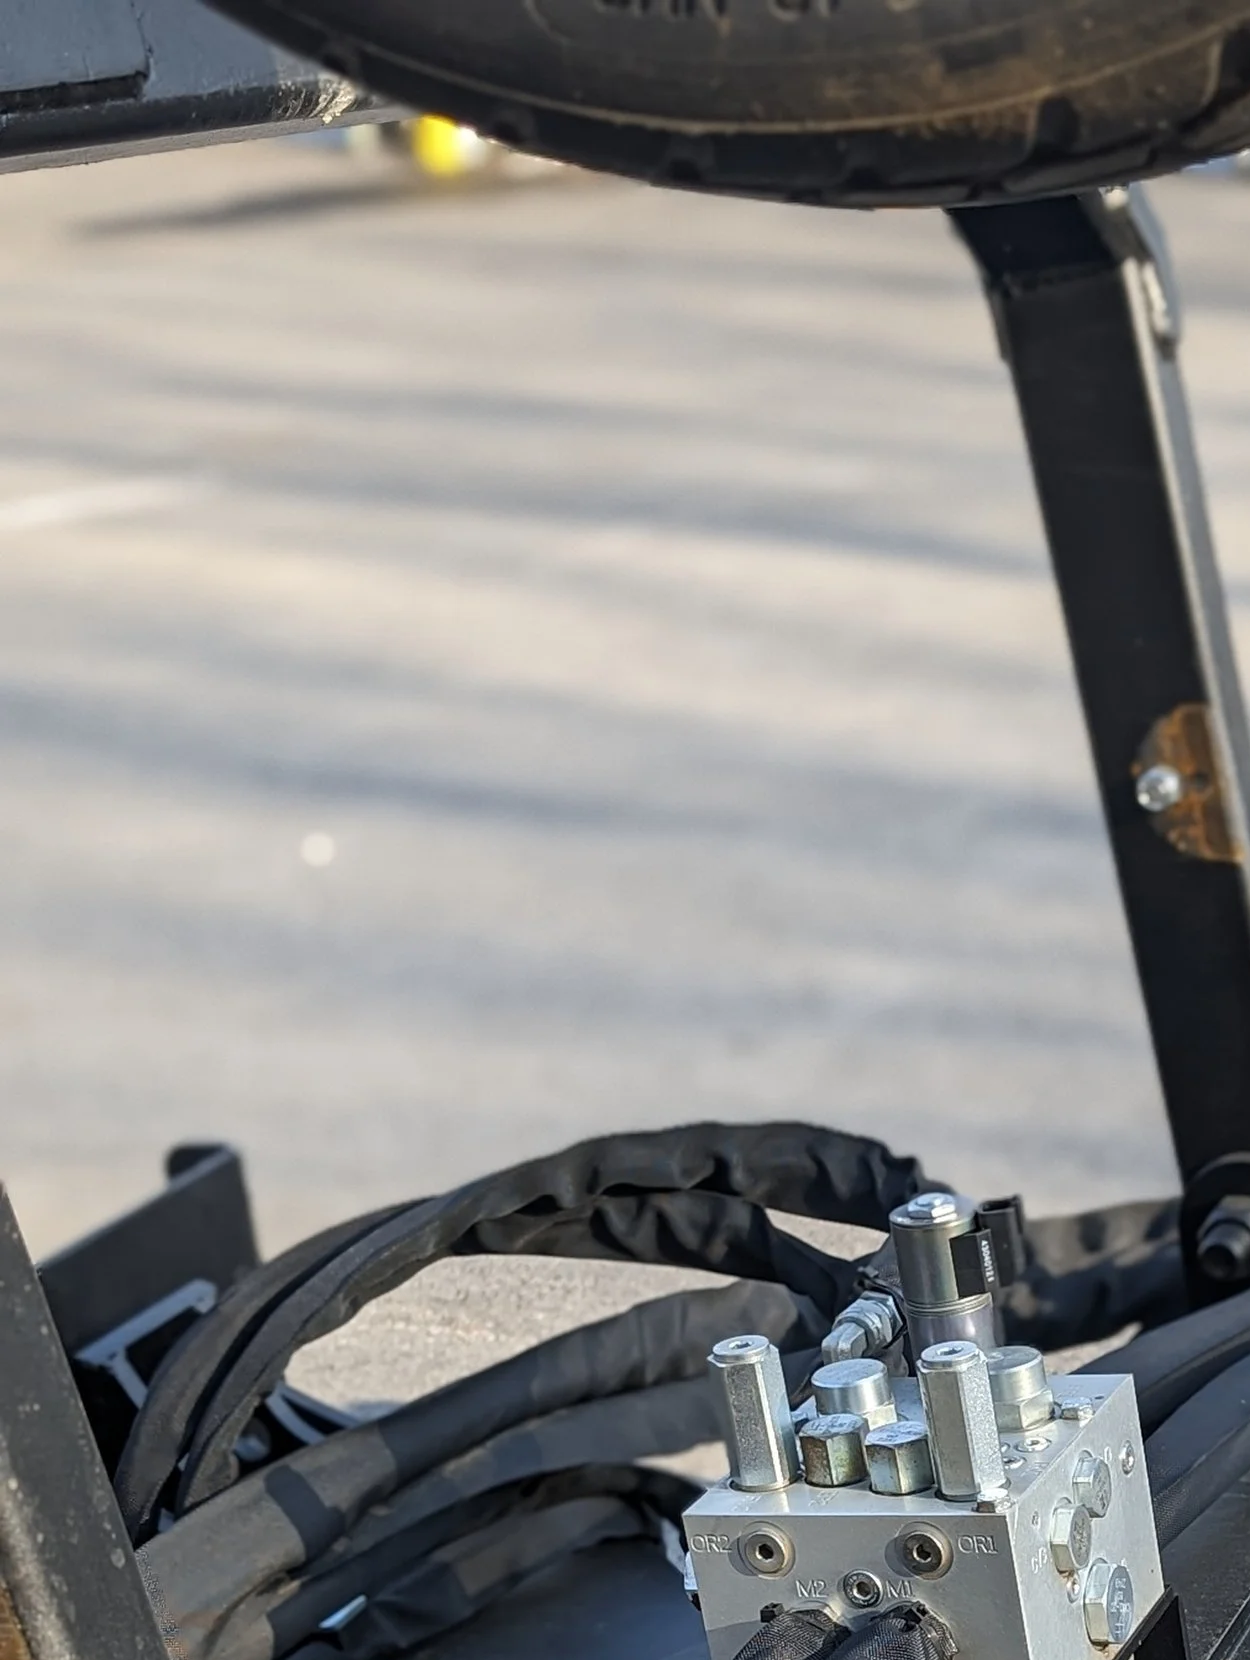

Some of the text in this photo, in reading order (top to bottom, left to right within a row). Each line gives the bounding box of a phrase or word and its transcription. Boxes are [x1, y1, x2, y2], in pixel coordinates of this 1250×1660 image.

[690, 1534, 732, 1553] OR2
[957, 1534, 998, 1554] OR1
[796, 1580, 828, 1598] M2
[885, 1580, 916, 1598] M1
